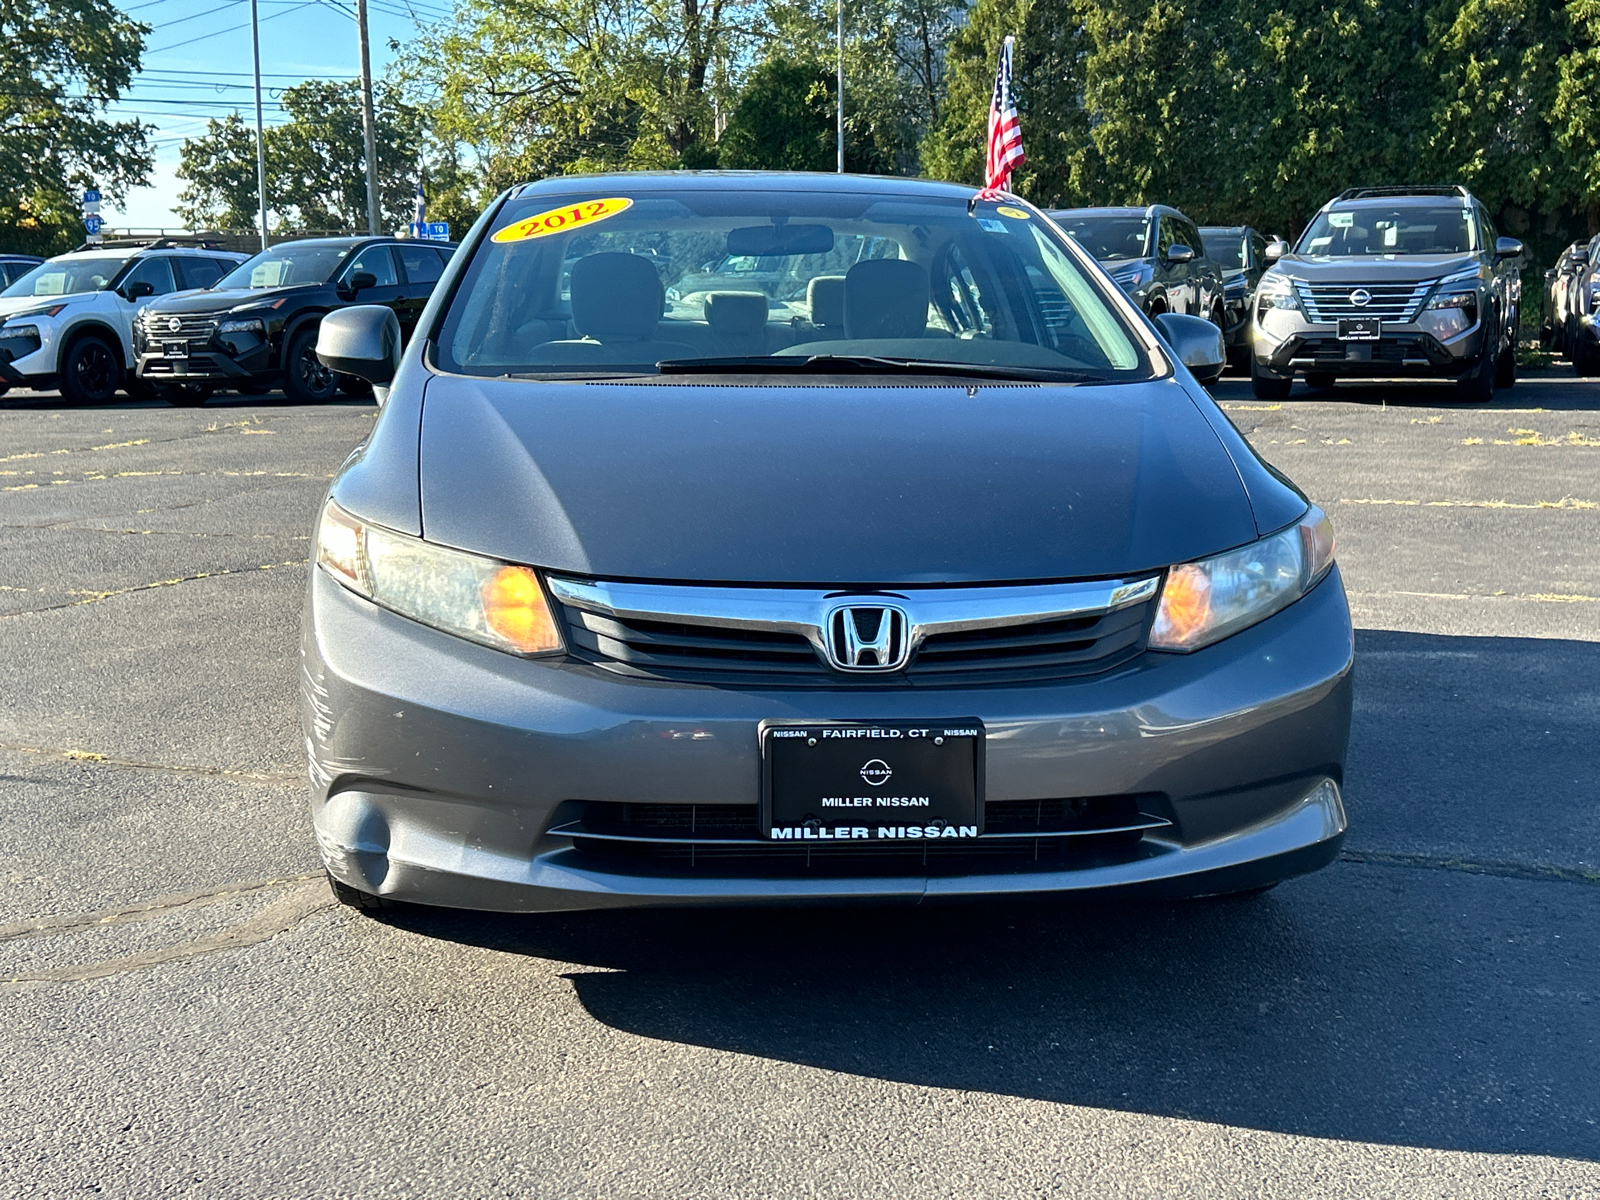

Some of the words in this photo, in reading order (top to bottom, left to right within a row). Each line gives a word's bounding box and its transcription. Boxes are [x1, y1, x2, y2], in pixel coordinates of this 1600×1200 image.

[520, 203, 609, 236] 2012
[87, 220, 99, 230] 95
[434, 225, 444, 233] TO
[822, 729, 904, 739] FAIRFIELD,
[908, 729, 929, 738] CT
[821, 797, 872, 807] MILLER
[876, 797, 929, 807] NISSAN
[771, 827, 869, 839] MILLER
[878, 826, 978, 838] NISSAN
